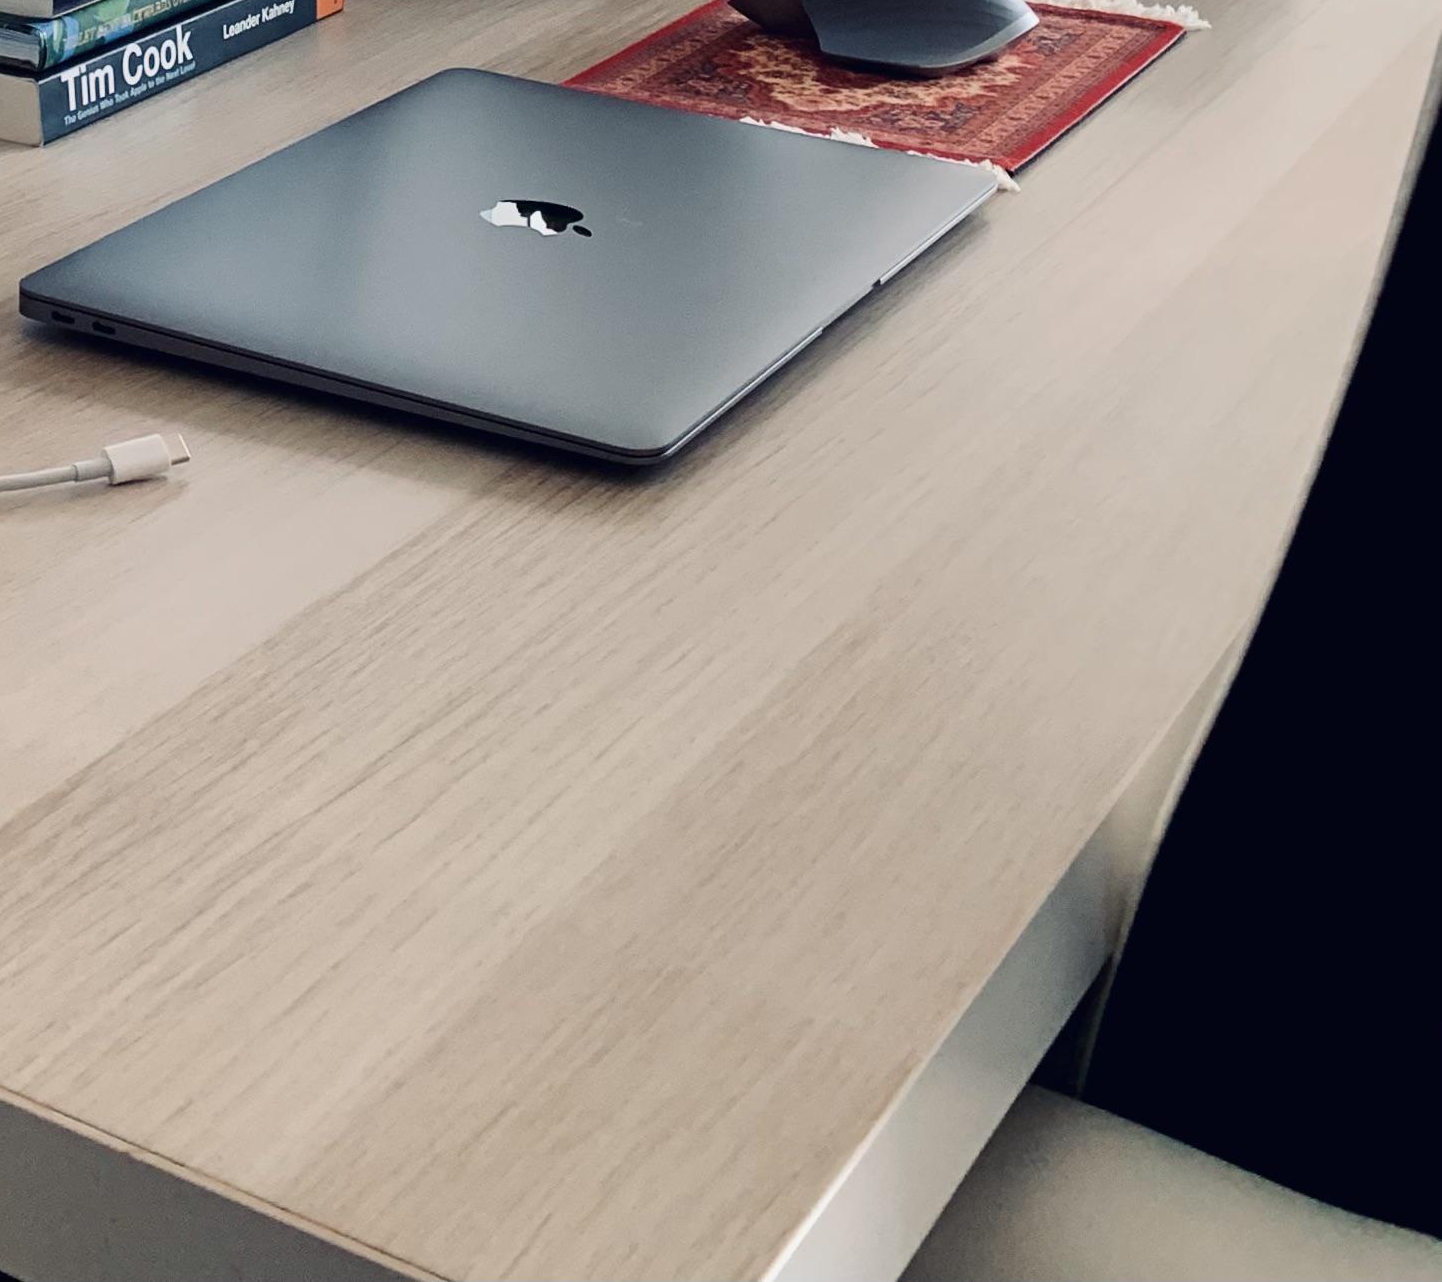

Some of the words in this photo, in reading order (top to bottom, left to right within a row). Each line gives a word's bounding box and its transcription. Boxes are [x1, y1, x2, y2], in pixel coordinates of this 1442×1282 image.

[60, 63, 115, 113] Tim
[122, 24, 195, 86] Cook
[222, 13, 261, 40] Leander
[63, 113, 77, 126] The
